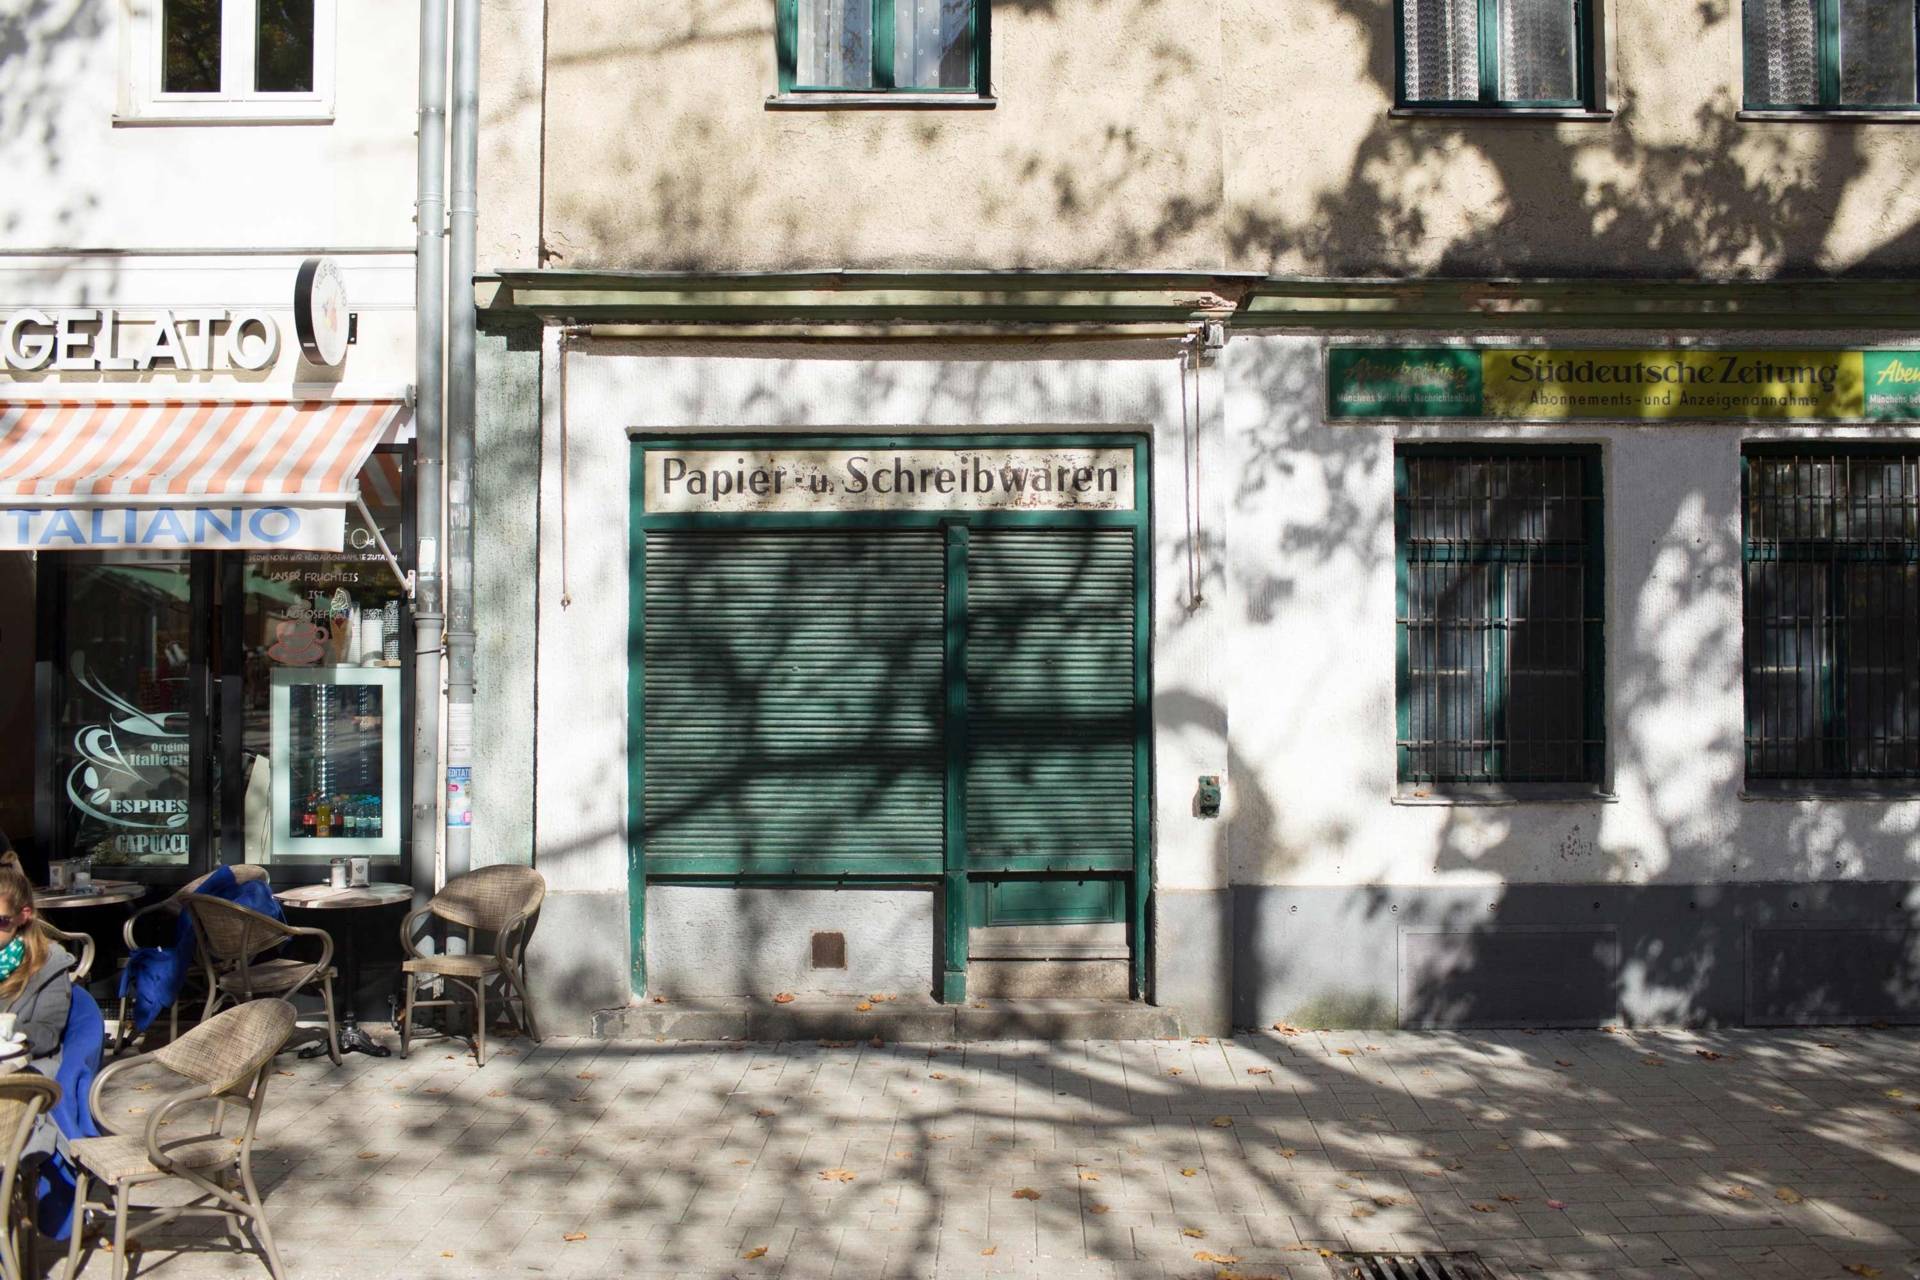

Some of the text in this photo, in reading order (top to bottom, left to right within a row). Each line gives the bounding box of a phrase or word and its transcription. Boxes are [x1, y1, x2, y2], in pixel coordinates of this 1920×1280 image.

[4, 308, 281, 371] GELATO
[1507, 354, 1839, 392] Süddeutsche Zeitung
[1680, 390, 1819, 409] Anzeigenannahme
[845, 456, 1119, 494] Schreibwaren
[304, 572, 359, 583] FRUCHTEIS
[308, 590, 325, 600] IST
[110, 799, 188, 813] ESPRES
